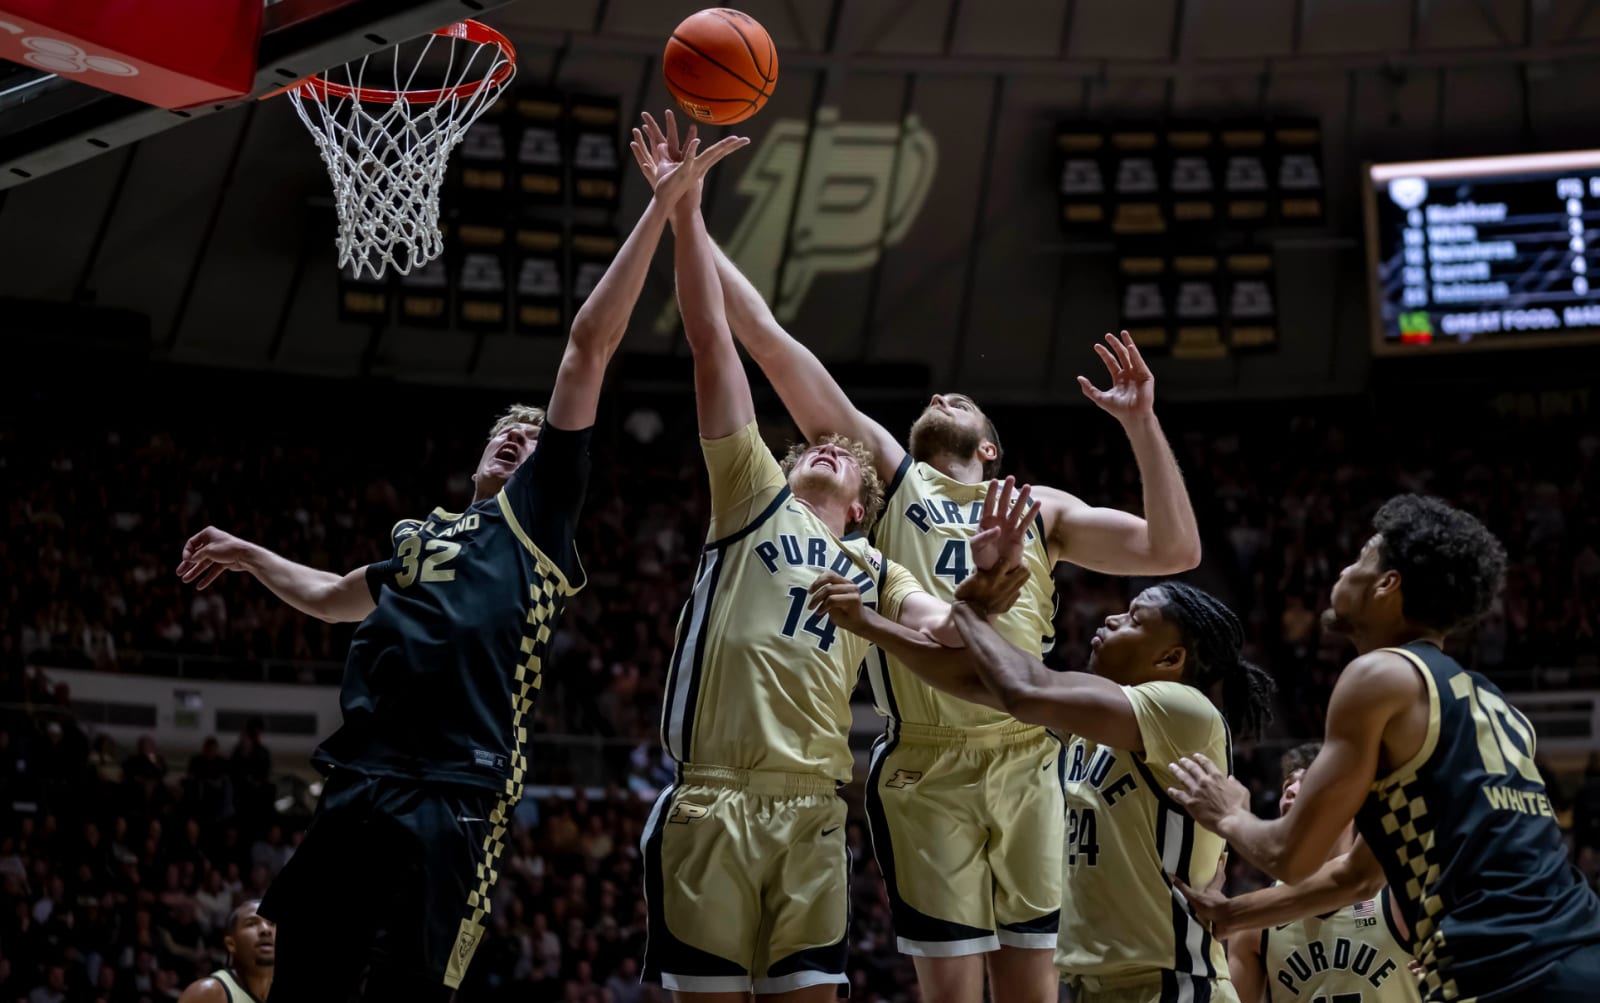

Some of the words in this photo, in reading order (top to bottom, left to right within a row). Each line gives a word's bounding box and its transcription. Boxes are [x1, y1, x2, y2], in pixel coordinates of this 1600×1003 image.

[395, 535, 462, 589] 32
[755, 535, 877, 611] PURDU
[781, 586, 837, 653] 14
[1449, 672, 1546, 786] 10
[1481, 785, 1553, 817] WHITE
[1068, 808, 1100, 866] 24
[1278, 938, 1397, 995] PURDUE
